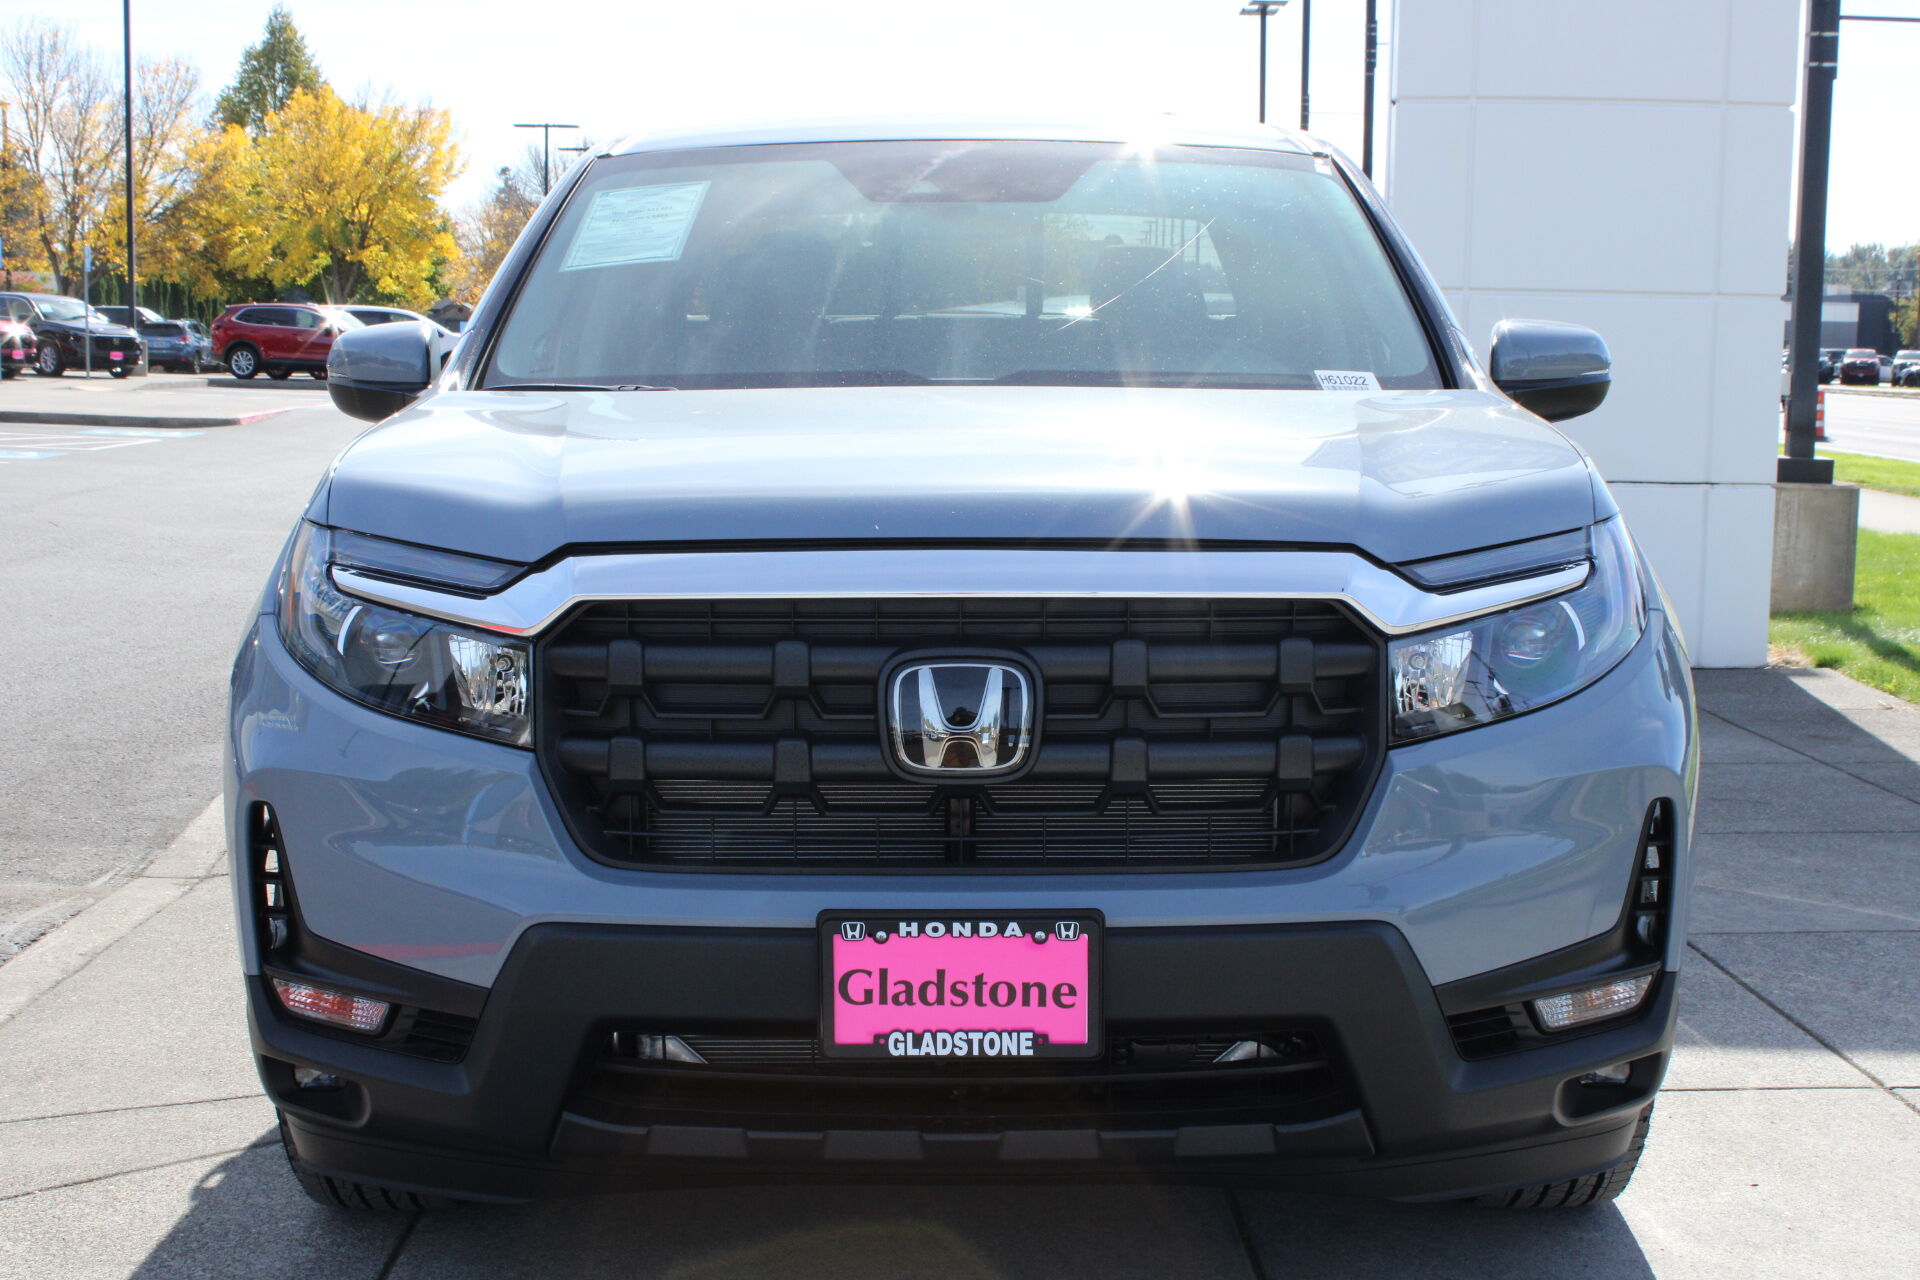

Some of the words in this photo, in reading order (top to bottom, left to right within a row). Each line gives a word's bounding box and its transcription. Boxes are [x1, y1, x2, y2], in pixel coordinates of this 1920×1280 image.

[1318, 374, 1369, 386] H61022
[899, 921, 1024, 938] HONDA
[837, 967, 1078, 1009] Gladstone
[888, 1031, 1034, 1056] GLADSTONE
